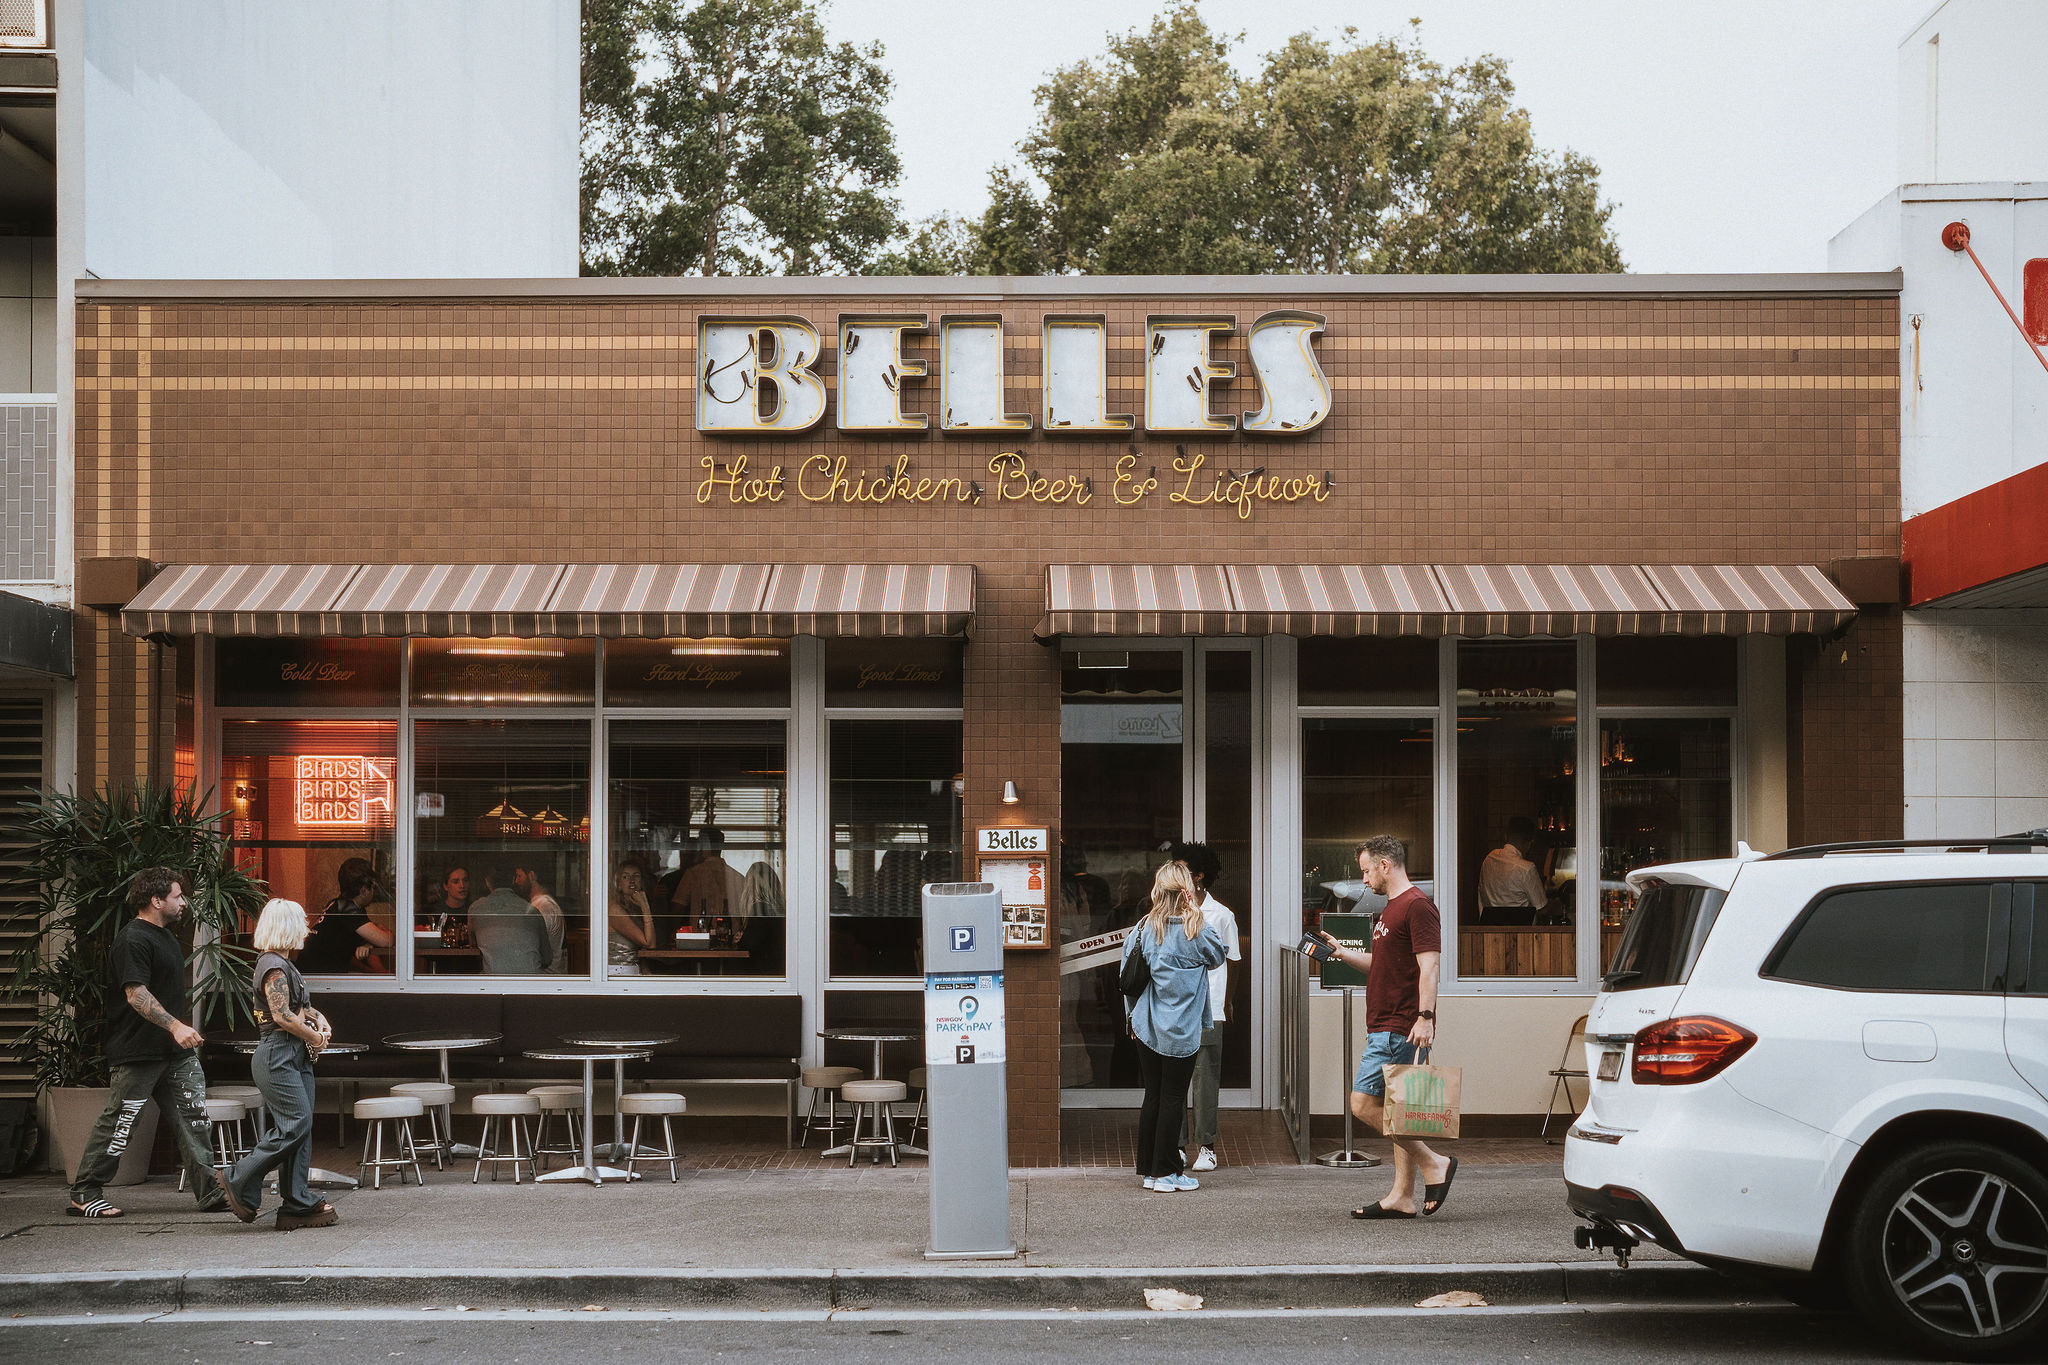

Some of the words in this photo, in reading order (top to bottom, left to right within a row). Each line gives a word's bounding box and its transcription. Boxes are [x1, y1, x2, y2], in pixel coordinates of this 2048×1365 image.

[695, 309, 1331, 435] BELLES
[695, 454, 785, 504] Hot
[988, 451, 1093, 505] Beer
[1113, 453, 1158, 504] &
[1170, 453, 1333, 520] Liquor
[281, 661, 319, 681] Cold
[316, 662, 357, 681] Beer
[642, 661, 695, 681] Hard
[689, 663, 742, 689] Liquor
[857, 663, 902, 689] Good
[896, 663, 943, 681] Times
[301, 760, 360, 779] BIRDS
[301, 780, 361, 799] BIRDS
[301, 801, 360, 820] BIRDS
[987, 830, 1038, 849] Belles
[954, 929, 971, 950] P
[1079, 937, 1105, 950] OPEN
[1108, 932, 1125, 942] TIL
[960, 1047, 971, 1062] P
